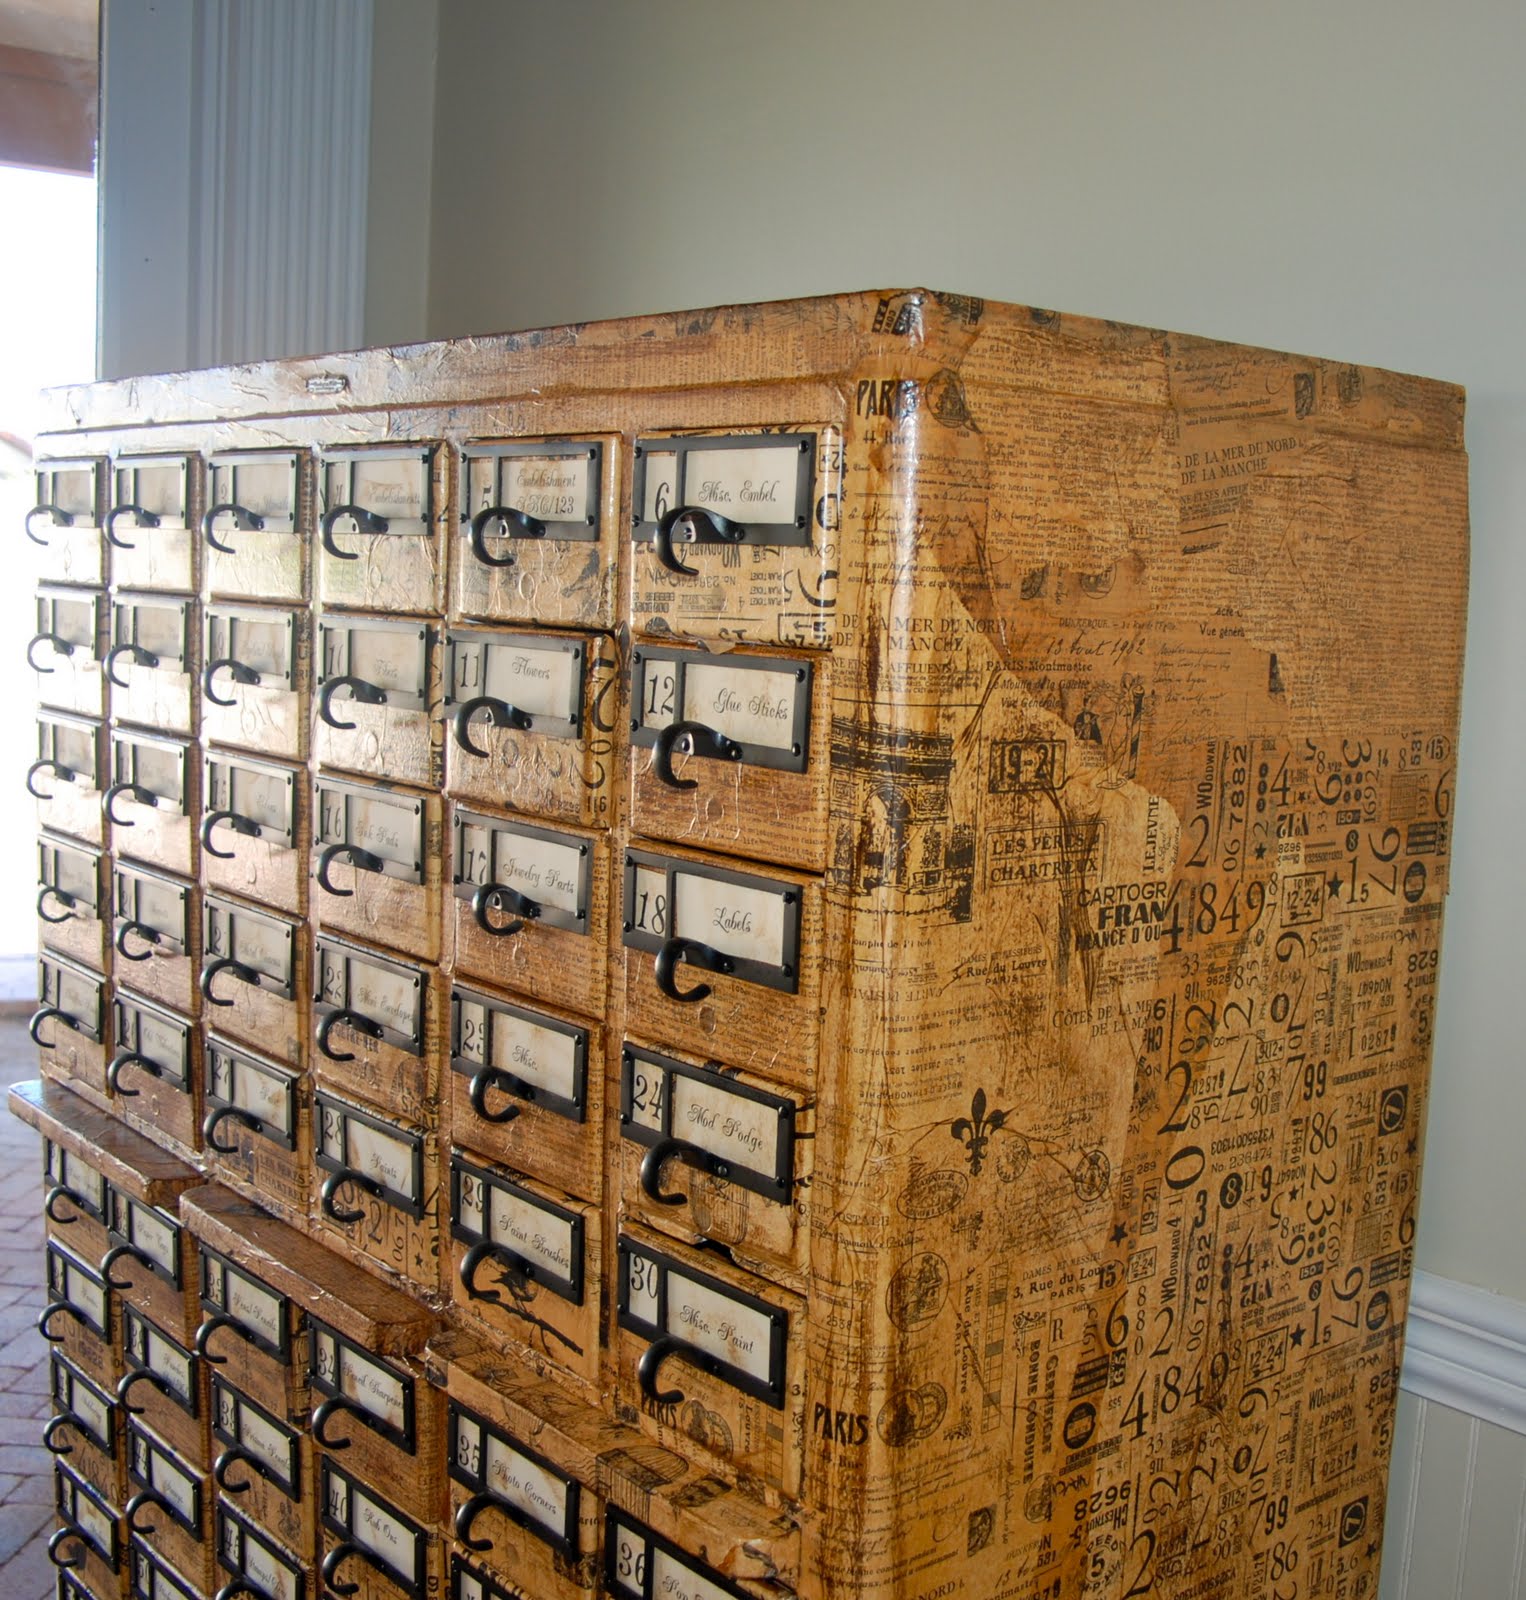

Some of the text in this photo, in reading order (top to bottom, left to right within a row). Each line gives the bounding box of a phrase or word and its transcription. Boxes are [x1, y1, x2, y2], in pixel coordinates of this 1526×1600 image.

[1185, 436, 1297, 468] DE LA MER DU NORD
[1181, 457, 1268, 485] DE LA MANCHE
[654, 482, 671, 520] 6
[836, 632, 964, 652] DE MANCHE
[842, 614, 858, 629] DE
[894, 617, 935, 634] MER
[940, 618, 961, 634] DU
[965, 618, 1007, 635] NORD
[1200, 623, 1216, 637] Vue
[460, 651, 480, 688] 11
[511, 655, 550, 681] Flowers
[647, 674, 675, 716] 12
[713, 687, 788, 721] Glue Sticks
[1316, 750, 1326, 775] 8
[1430, 737, 1444, 761] 15
[1270, 751, 1292, 808] 4
[1434, 768, 1451, 819] 6
[324, 805, 342, 838] 16
[991, 837, 1028, 856] LES
[1184, 813, 1210, 869] 2
[466, 848, 487, 885] 17
[502, 857, 575, 895] Jewelry Parts
[990, 857, 1099, 883] CHARTREUX
[1076, 881, 1168, 908] CARTOGR
[1287, 887, 1320, 911] 12-24
[636, 890, 667, 936] 18
[711, 906, 752, 933] Labels
[1098, 900, 1169, 931] FRAN
[966, 958, 1048, 978] Rue du Louvre
[984, 973, 1020, 986] PARIS
[1052, 1007, 1093, 1029] CÔTES
[1097, 1005, 1112, 1021] DE
[1091, 1022, 1107, 1038] DE
[631, 1074, 664, 1121] 24
[1157, 1060, 1193, 1136] 2
[1303, 1060, 1328, 1101] 99
[686, 1103, 764, 1155] Mod Podge
[1136, 1160, 1157, 1176] 289
[461, 1174, 483, 1214] 29
[1140, 1185, 1158, 1229] 19-21
[498, 1213, 570, 1269] Paint Brushes
[630, 1254, 659, 1299] 30
[1130, 1256, 1154, 1274] 12-24
[1160, 1215, 1182, 1304] WOODWARD 4
[1029, 1272, 1075, 1295] Rue du
[1050, 1283, 1086, 1300] PARIS
[1051, 1317, 1065, 1343] R
[1104, 1289, 1130, 1348] 6
[1148, 1306, 1175, 1360] 2
[717, 1321, 755, 1356] Paint
[1249, 1341, 1284, 1369] 12-24
[1026, 1339, 1042, 1396] BONNE
[812, 1401, 869, 1447] PARIS
[457, 1434, 481, 1476] 35
[491, 1458, 557, 1516] Photo Corners
[618, 1541, 645, 1588] 36
[1122, 1528, 1156, 1600] 2
